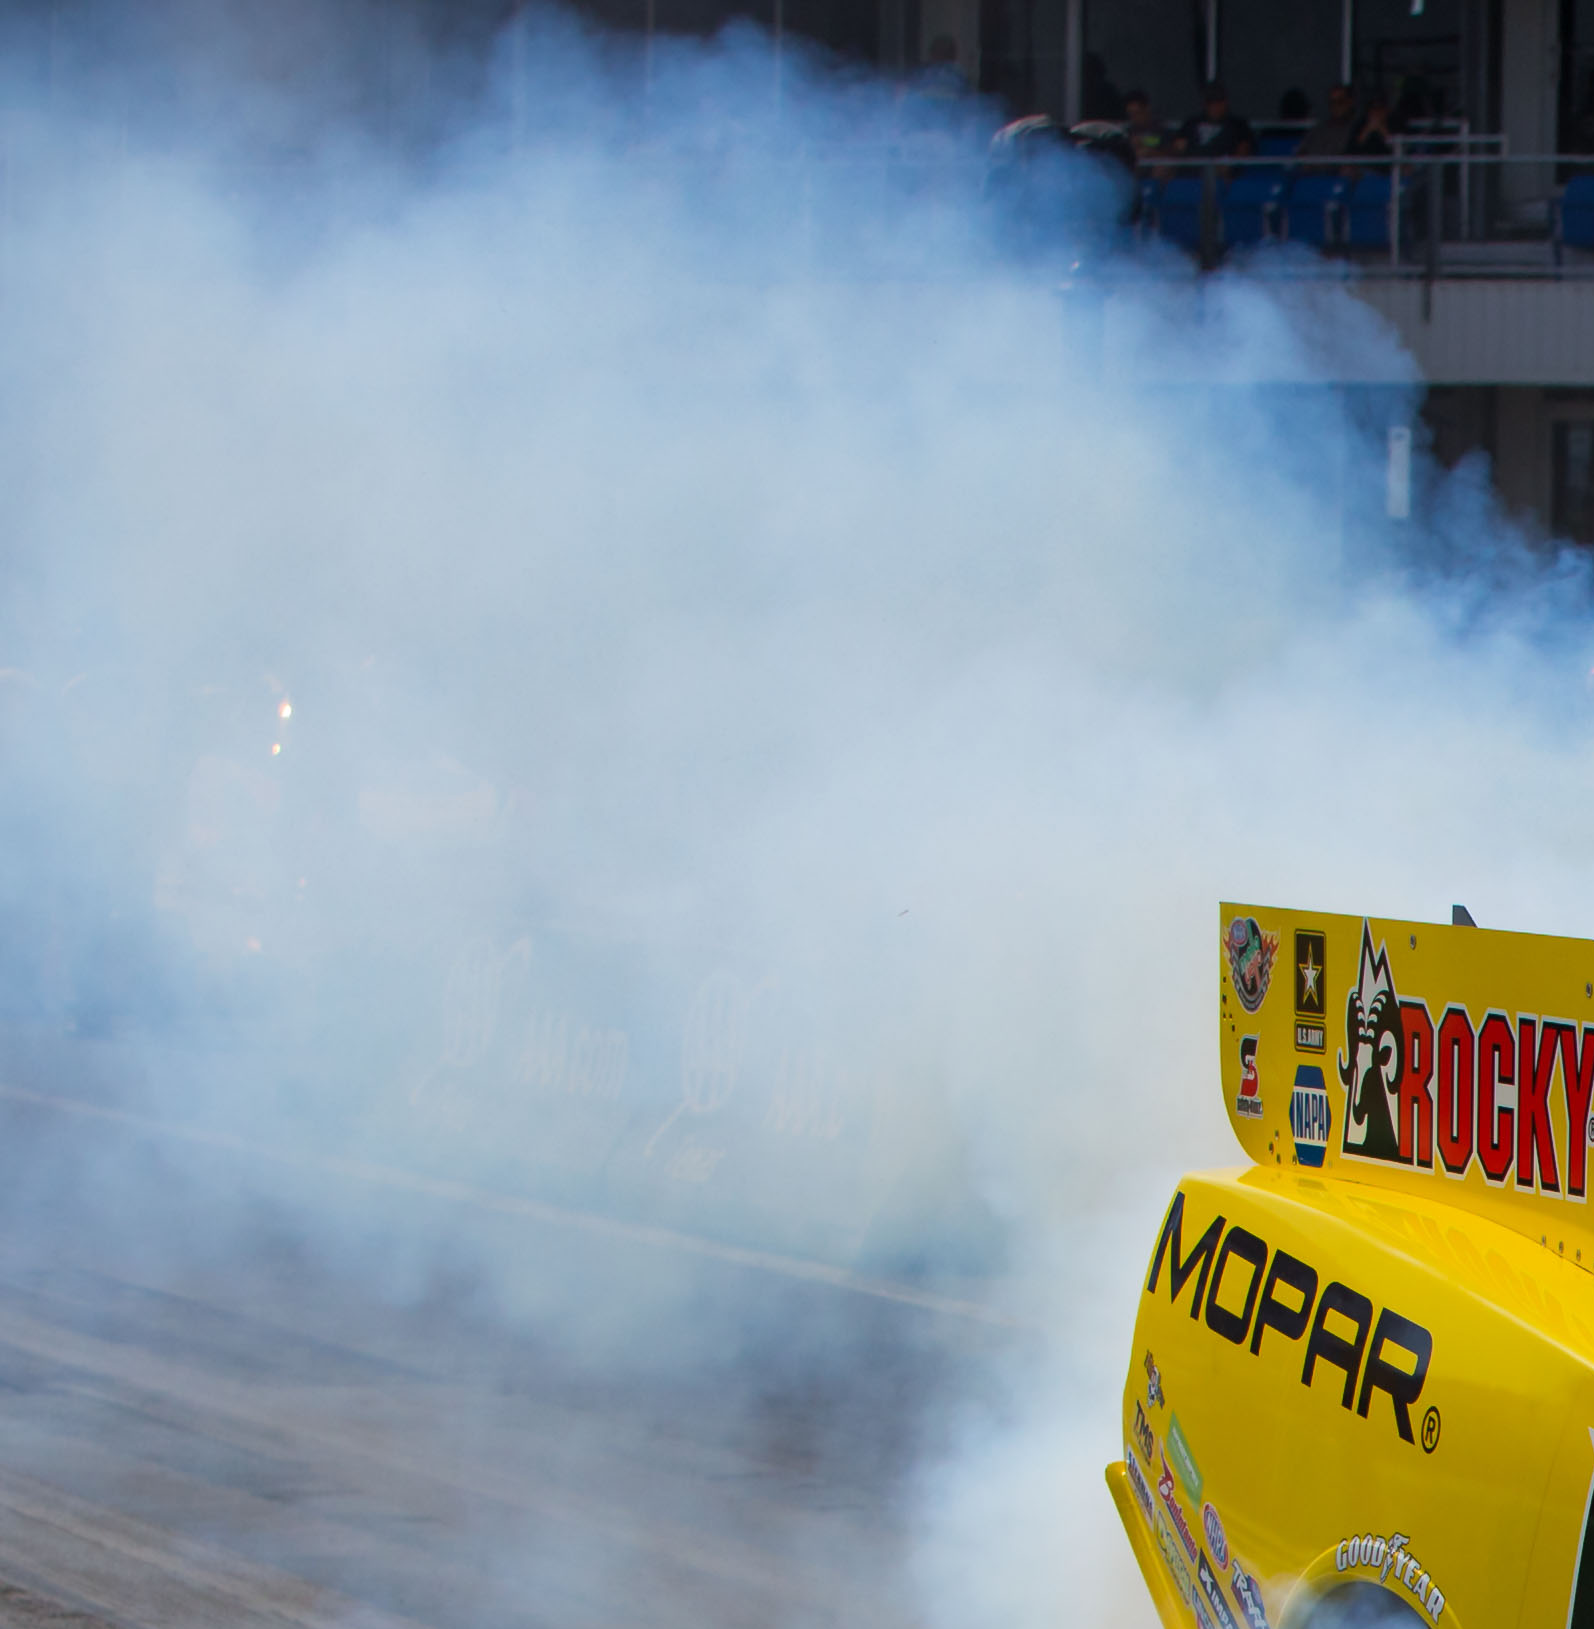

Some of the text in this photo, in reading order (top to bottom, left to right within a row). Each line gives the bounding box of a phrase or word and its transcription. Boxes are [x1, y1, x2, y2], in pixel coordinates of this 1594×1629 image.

[1293, 1091, 1329, 1142] NAPA
[1147, 1191, 1433, 1446] MOPAR
[1335, 1532, 1446, 1625] GOODYEAR
